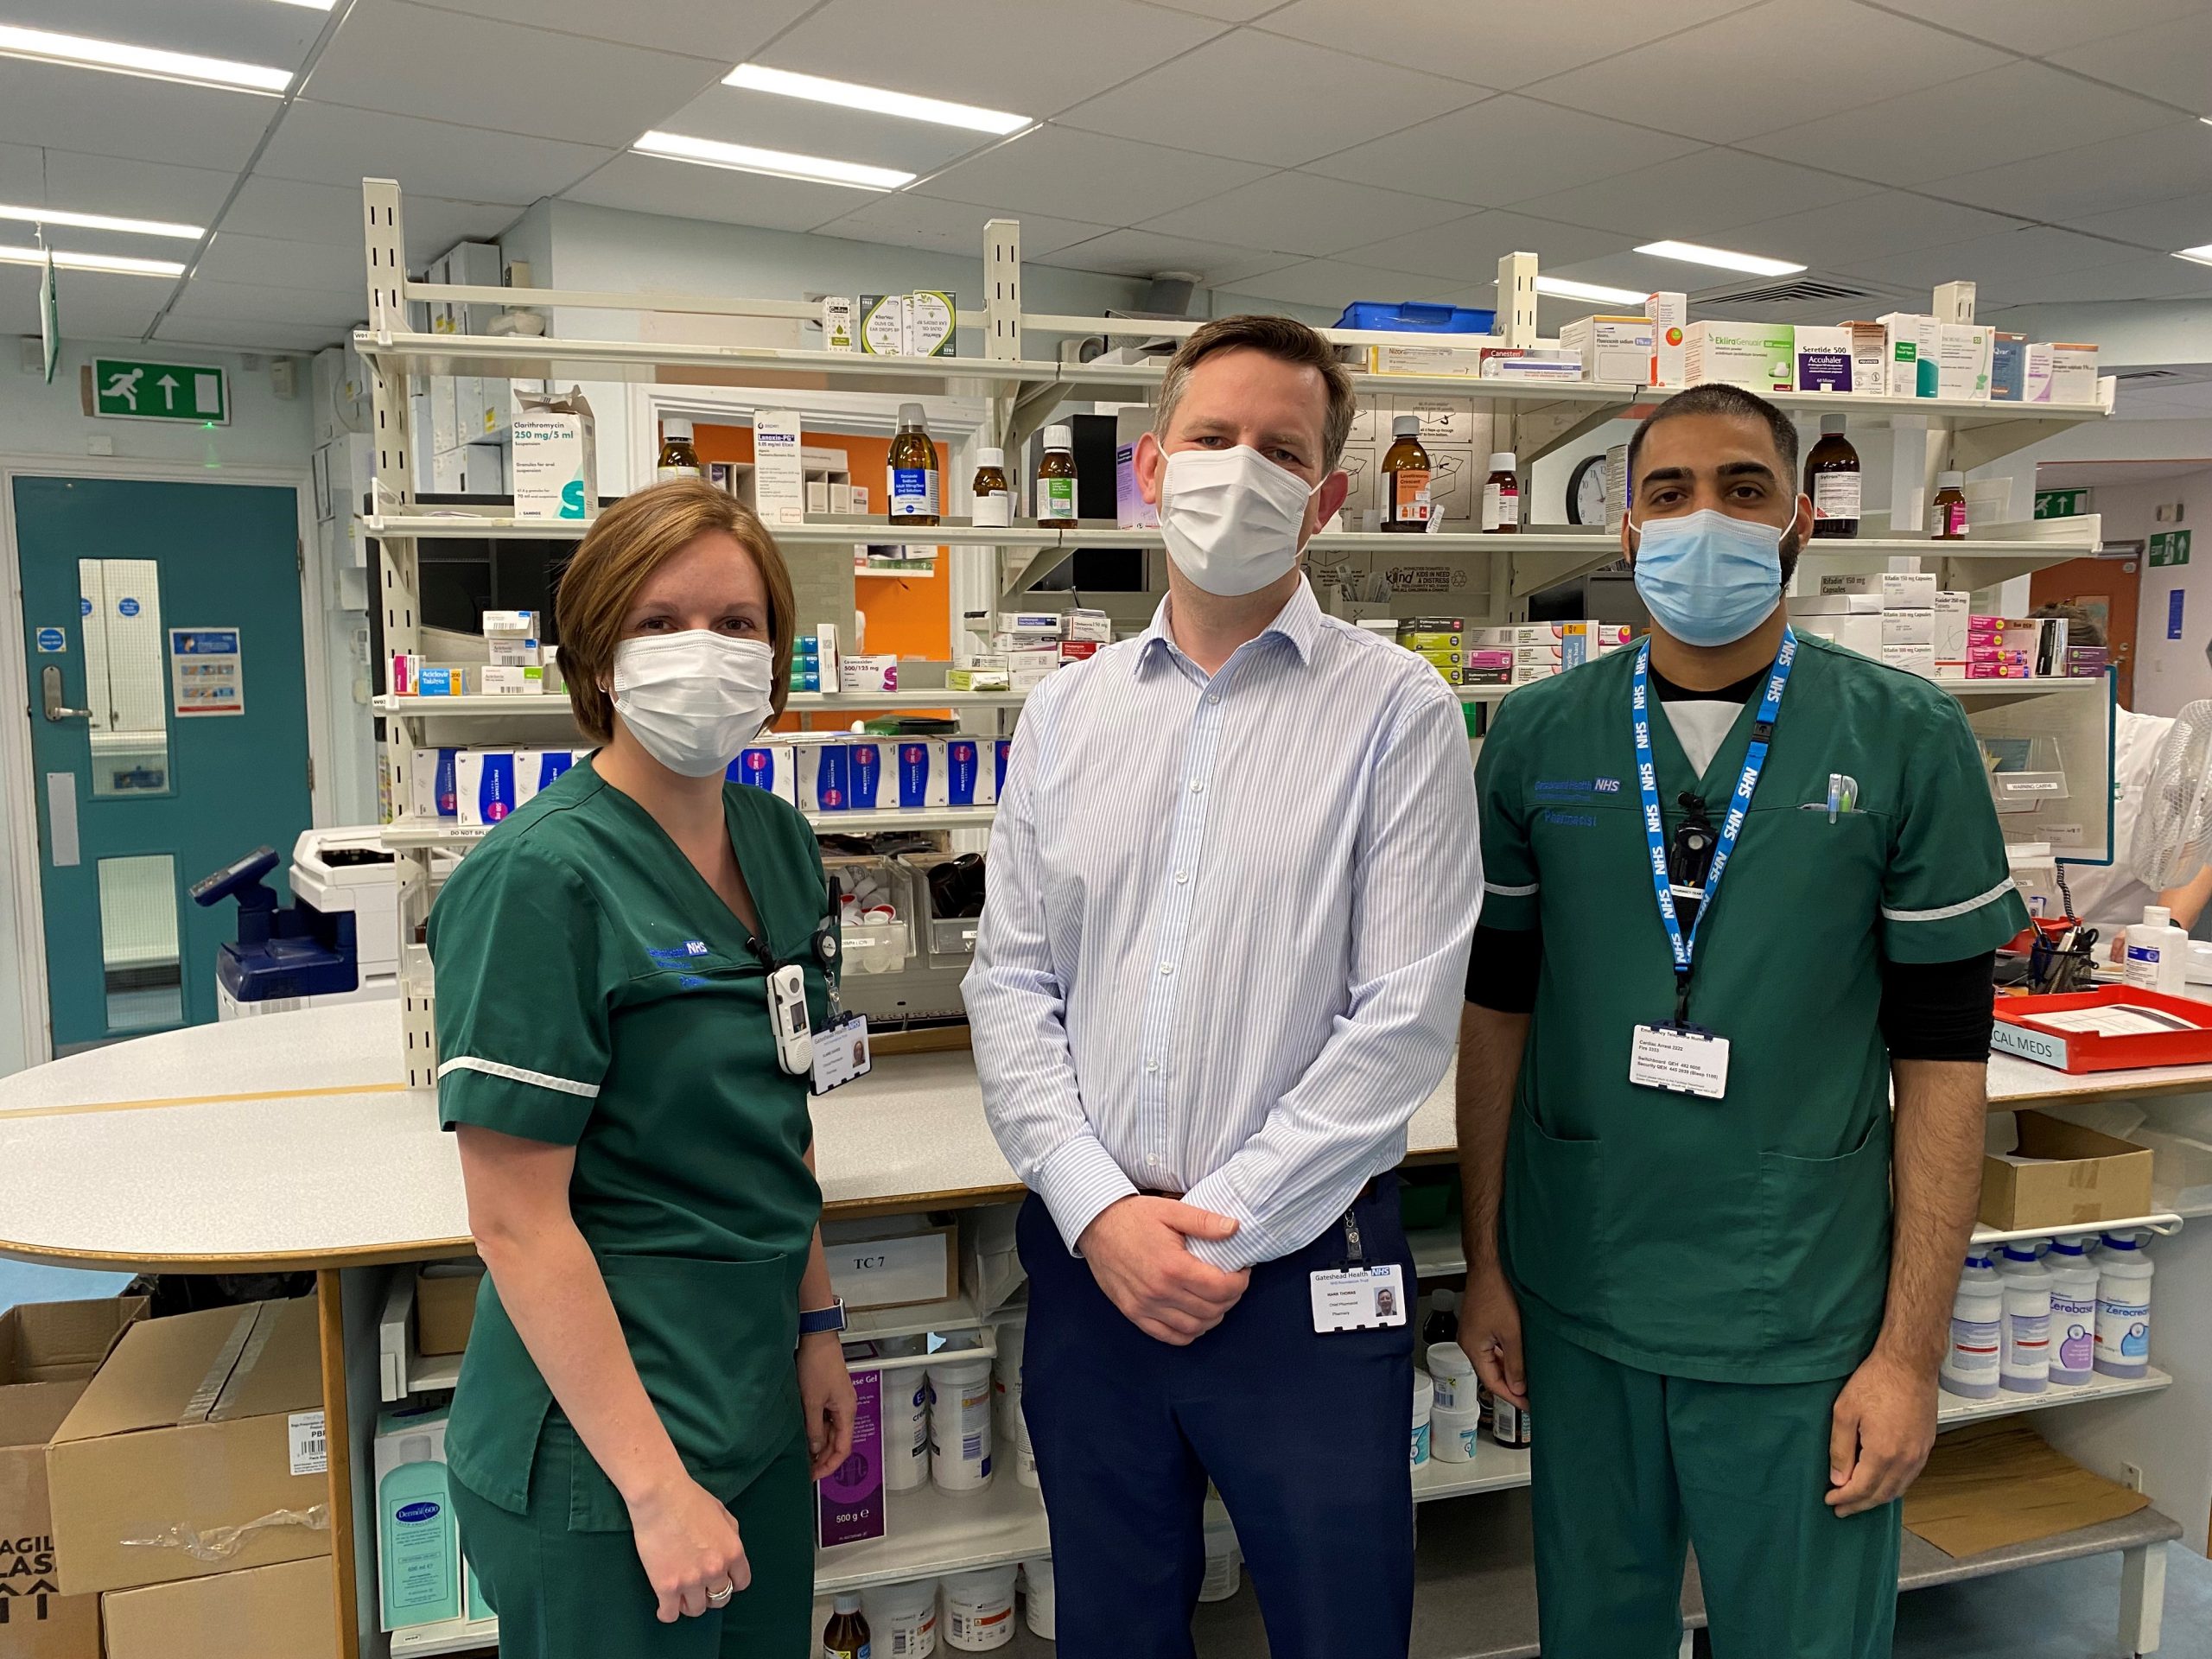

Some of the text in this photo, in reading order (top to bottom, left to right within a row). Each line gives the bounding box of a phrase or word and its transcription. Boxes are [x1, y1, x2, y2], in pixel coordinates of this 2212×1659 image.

[534, 431, 559, 440] mg/5
[562, 430, 574, 439] ml
[1591, 469, 1596, 478] 11
[1636, 652, 1646, 676] NHS
[1778, 640, 1795, 666] NHS
[1634, 685, 1644, 709] NHS
[1767, 676, 1784, 702] NHS
[1636, 721, 1649, 748] NHS
[1594, 779, 1620, 791] NHS
[1640, 762, 1654, 791] NHS
[1738, 766, 1758, 799] NHS
[1646, 804, 1660, 832] NHS
[1724, 809, 1744, 841] NHS
[1652, 846, 1665, 874] NHS
[1710, 851, 1727, 883] NHS
[1659, 889, 1675, 918] NHS
[687, 942, 707, 955] NHS
[1671, 933, 1686, 963] NHS
[1993, 1030, 2052, 1057] CAL MEDS
[1638, 1056, 1666, 1065] Switchboard
[853, 1256, 885, 1269] TC 7
[1371, 1268, 1389, 1276] NHS
[866, 1374, 877, 1382] Gel
[398, 1505, 439, 1518] Dermol 600
[836, 1513, 857, 1523] 500 g
[0, 1535, 54, 1555] AGIL
